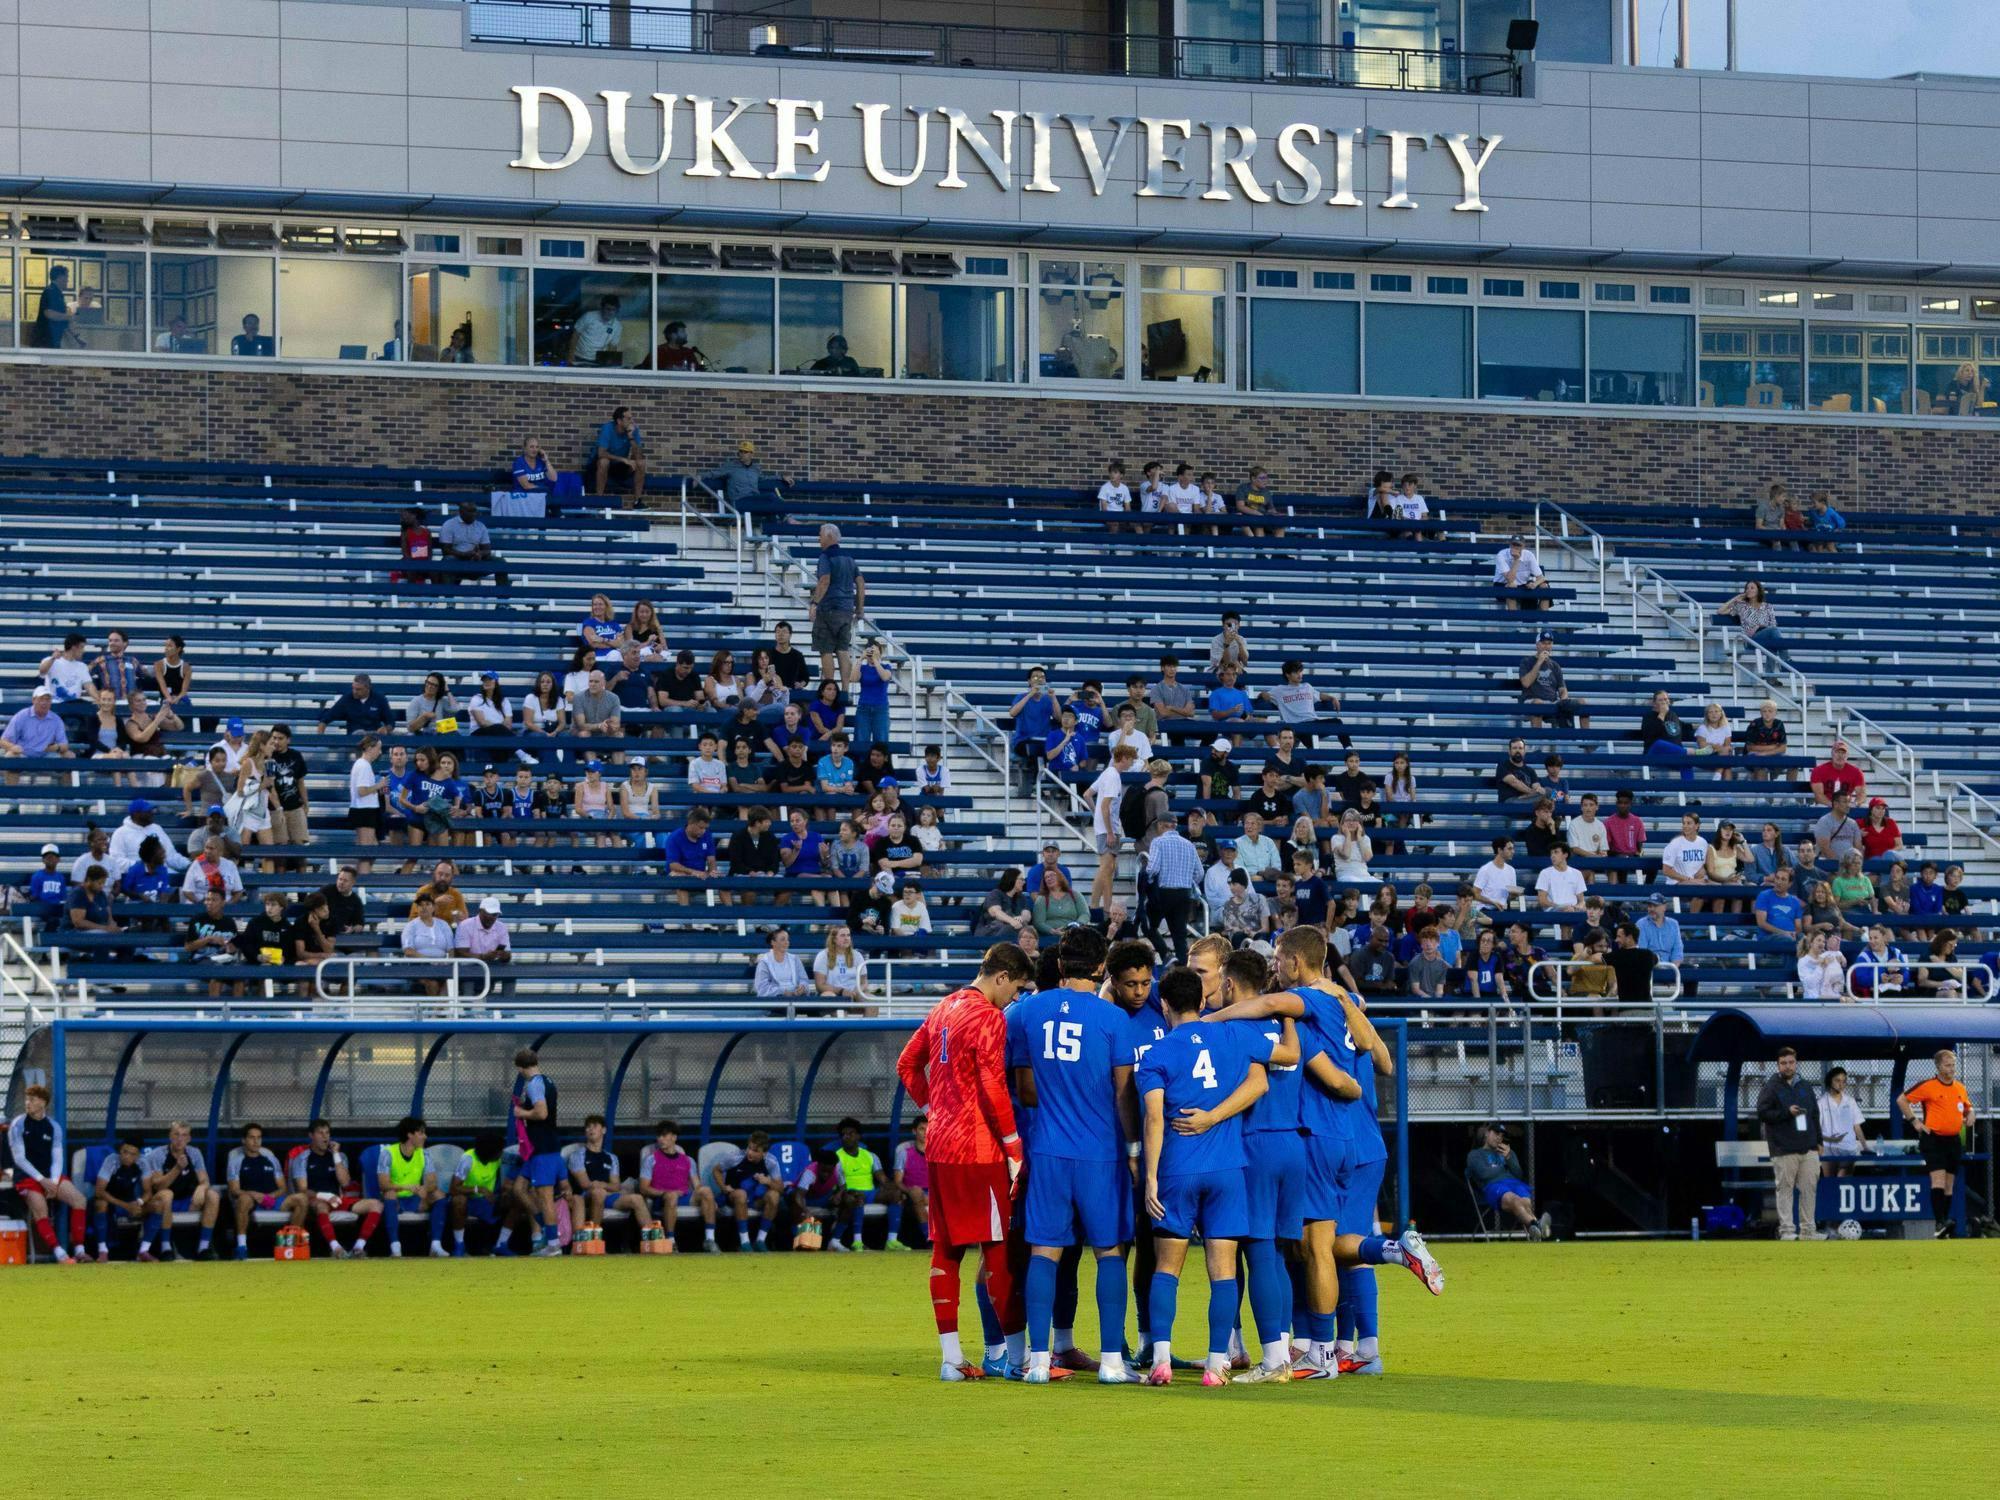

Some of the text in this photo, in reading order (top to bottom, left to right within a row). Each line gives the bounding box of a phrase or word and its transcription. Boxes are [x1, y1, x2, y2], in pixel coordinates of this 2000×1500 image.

[509, 84, 1504, 213] DUKE UNIVERSITY
[1683, 850, 1705, 862] DUKE
[939, 1027, 948, 1064] 1
[1042, 1020, 1083, 1062] 15
[1192, 1049, 1218, 1089] 4
[1839, 1184, 1921, 1213] DUKE
[284, 1248, 294, 1259] G
